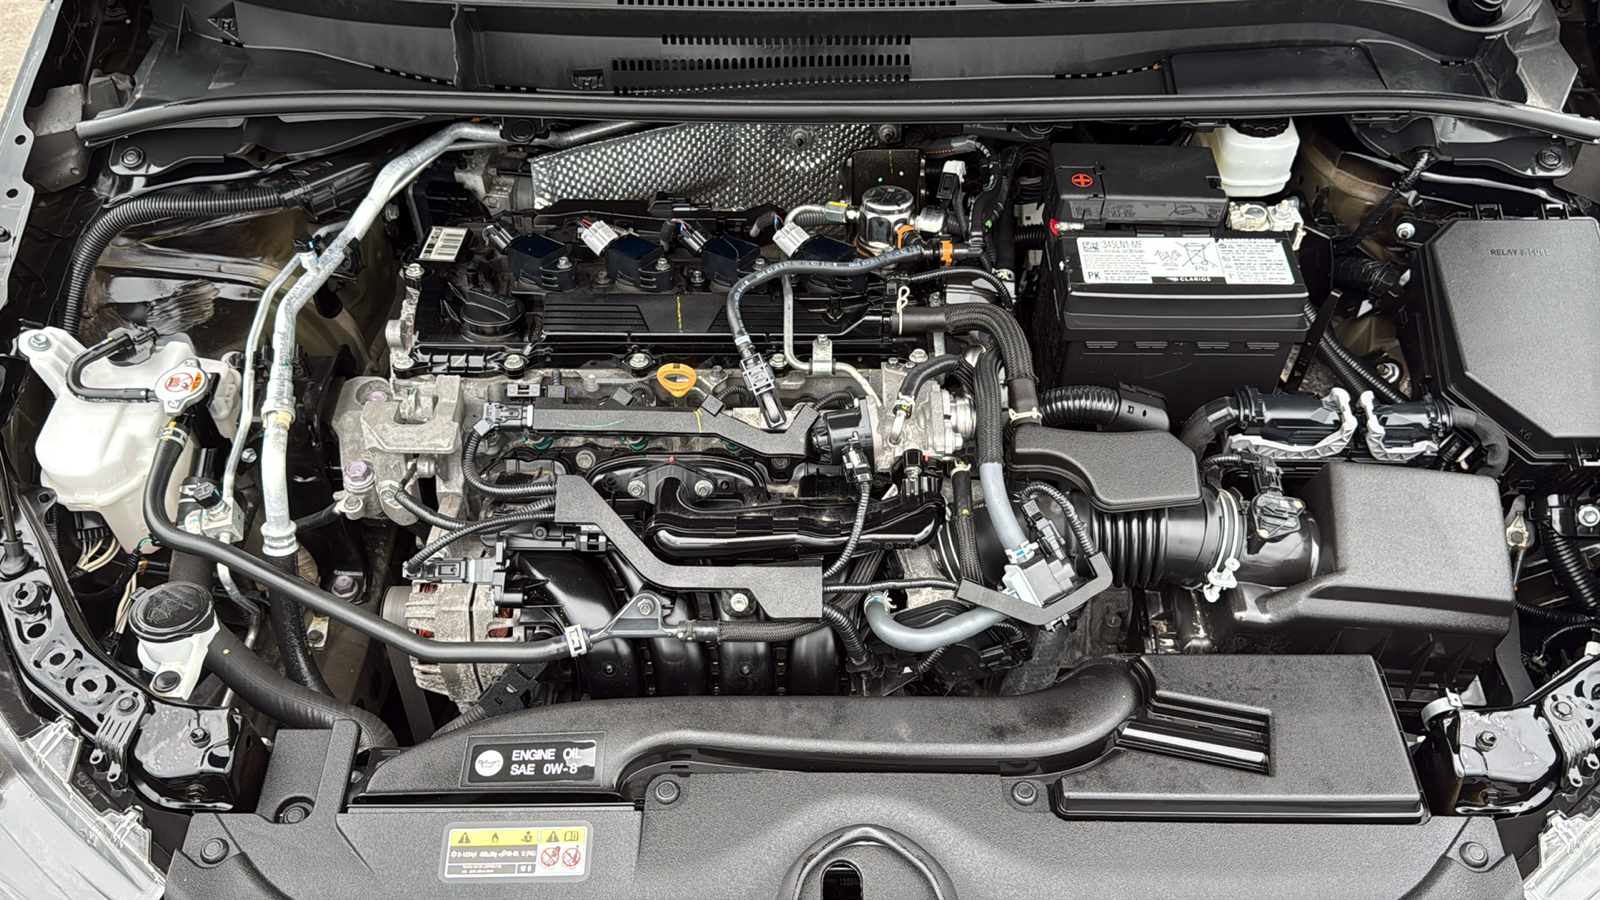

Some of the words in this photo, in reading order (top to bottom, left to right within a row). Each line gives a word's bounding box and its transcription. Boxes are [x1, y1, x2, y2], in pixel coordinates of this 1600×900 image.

[1087, 271, 1101, 280] PK
[511, 749, 556, 761] ENGINE
[562, 747, 582, 760] OIL
[510, 764, 535, 776] SAE
[543, 762, 578, 775] 0W-8
